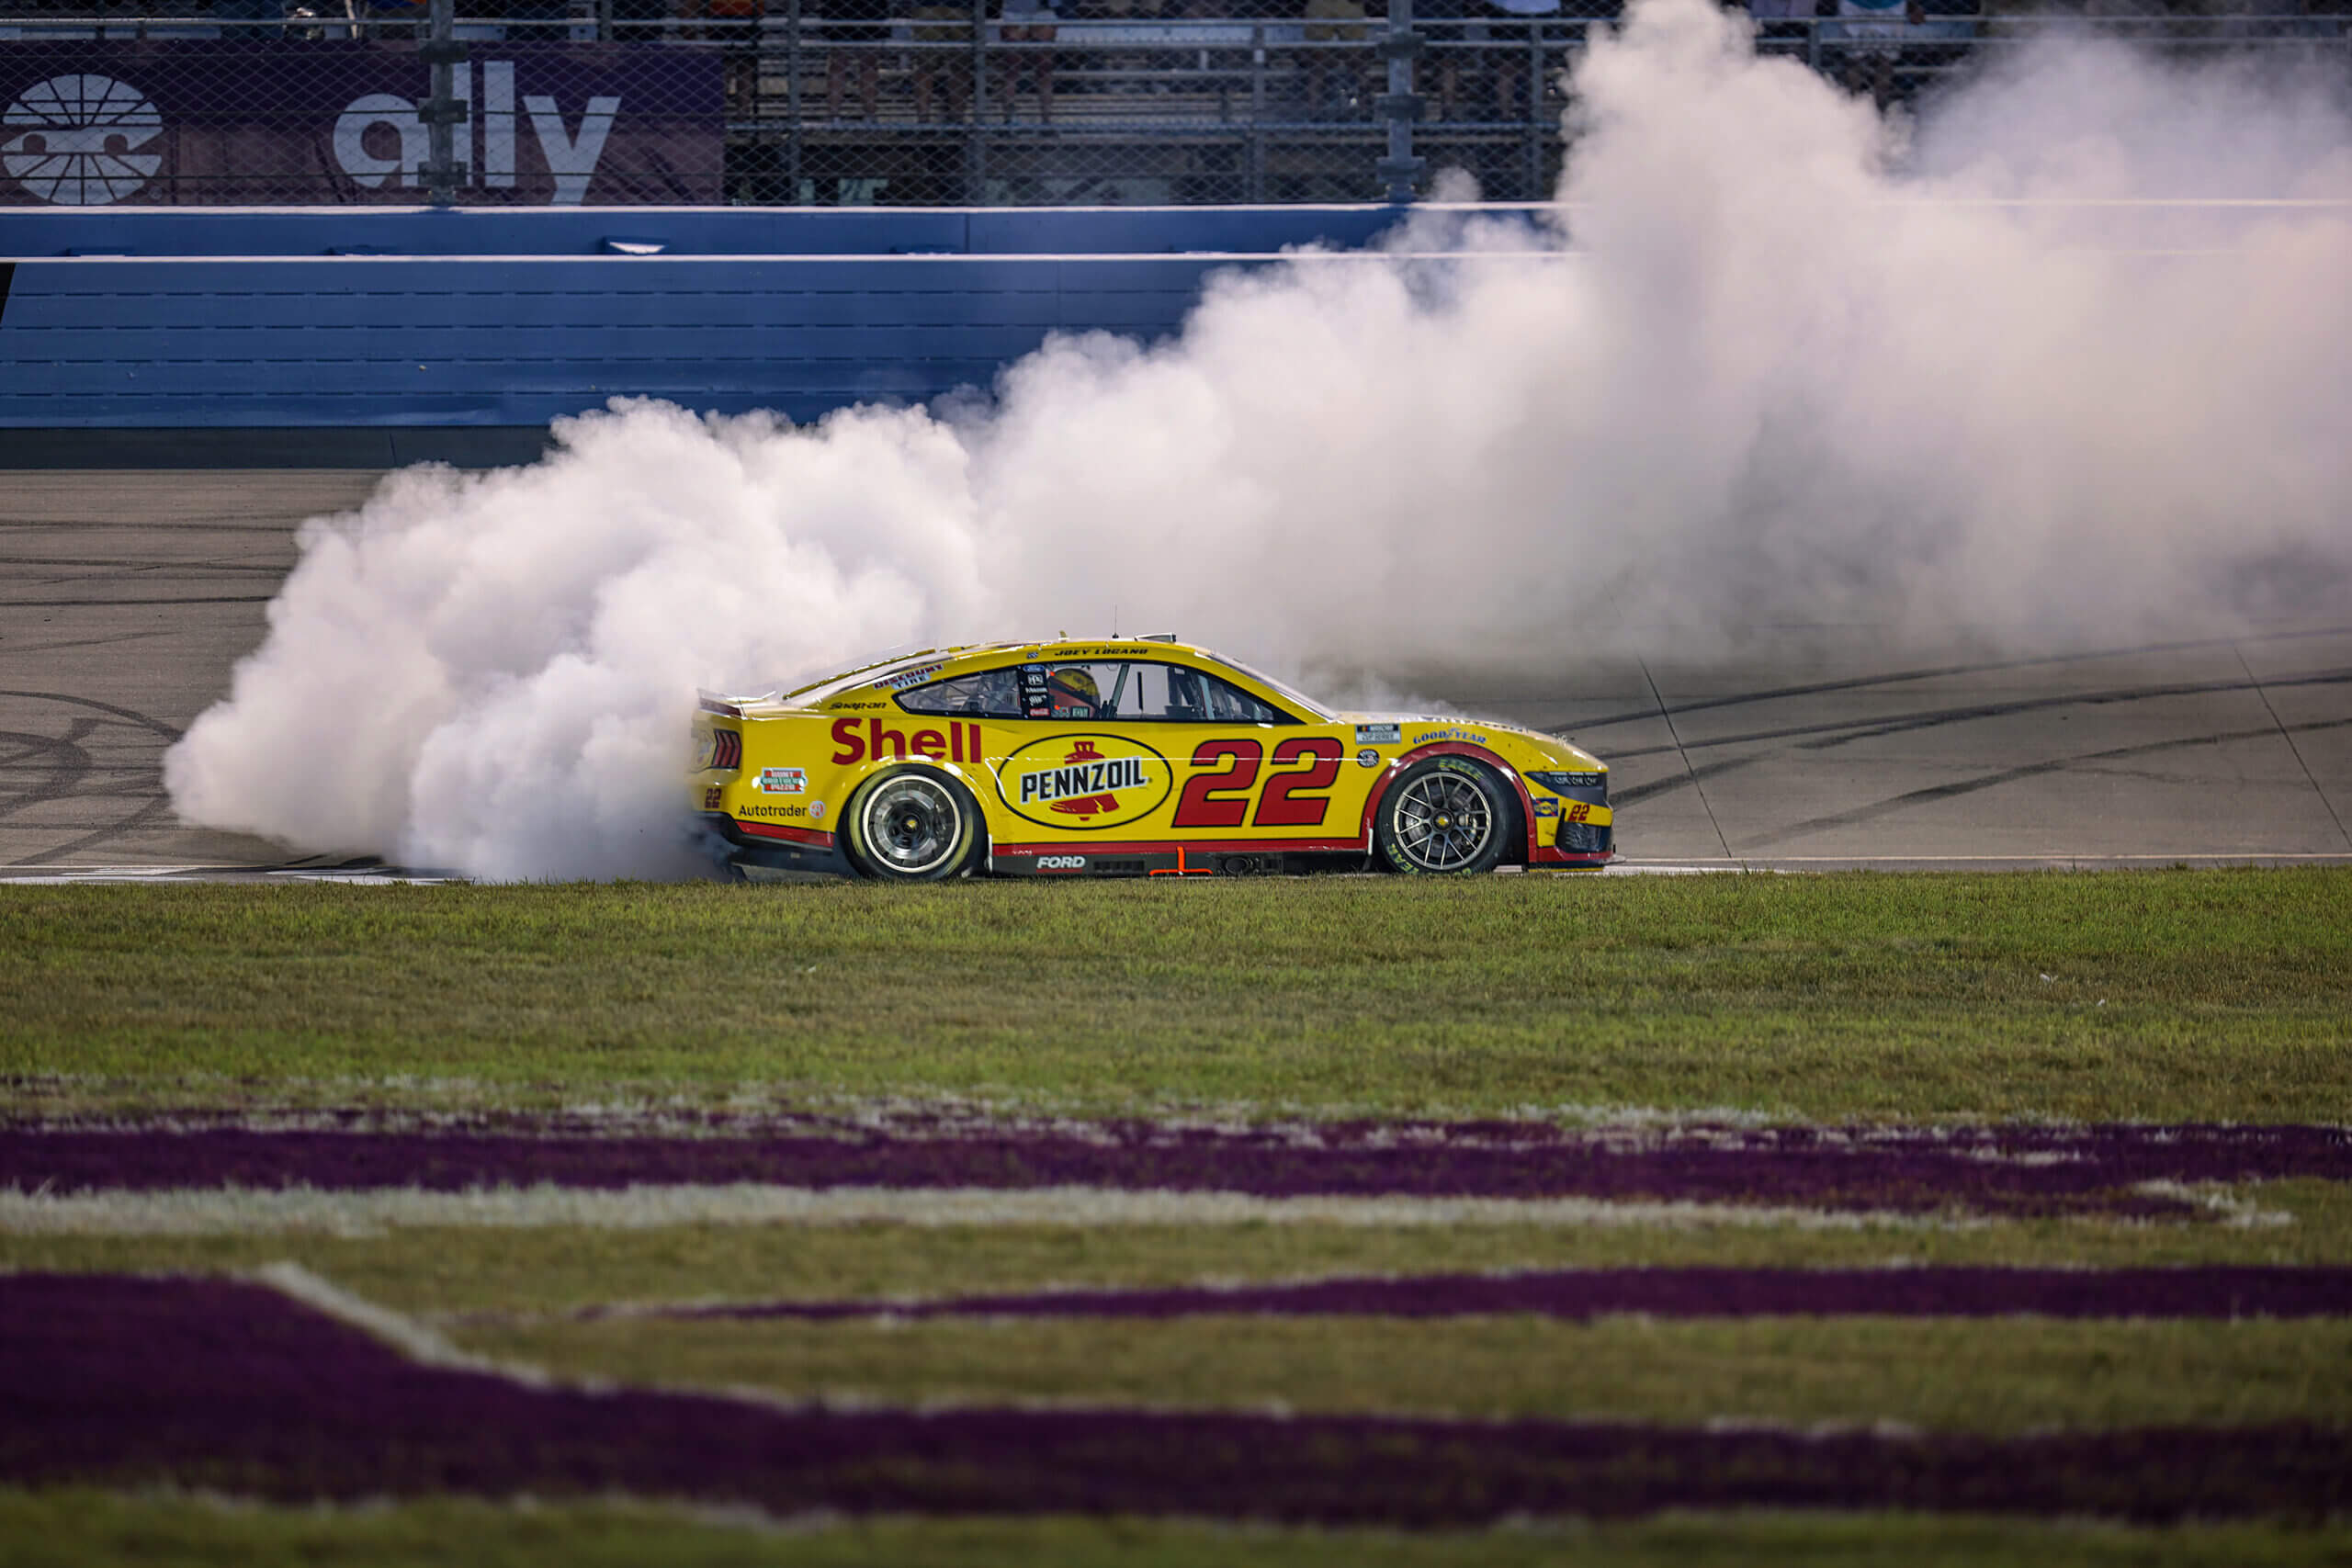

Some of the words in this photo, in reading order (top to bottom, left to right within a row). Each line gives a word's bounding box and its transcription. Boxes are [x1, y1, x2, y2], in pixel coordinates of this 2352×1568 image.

[334, 61, 622, 207] ally
[831, 717, 982, 765] Shell
[1021, 757, 1148, 804] PENNZOIL
[1170, 738, 1344, 829] 22
[705, 787, 723, 809] 22
[738, 805, 808, 817] Autotrader
[1567, 804, 1590, 822] 22
[1036, 856, 1086, 869] FORD
